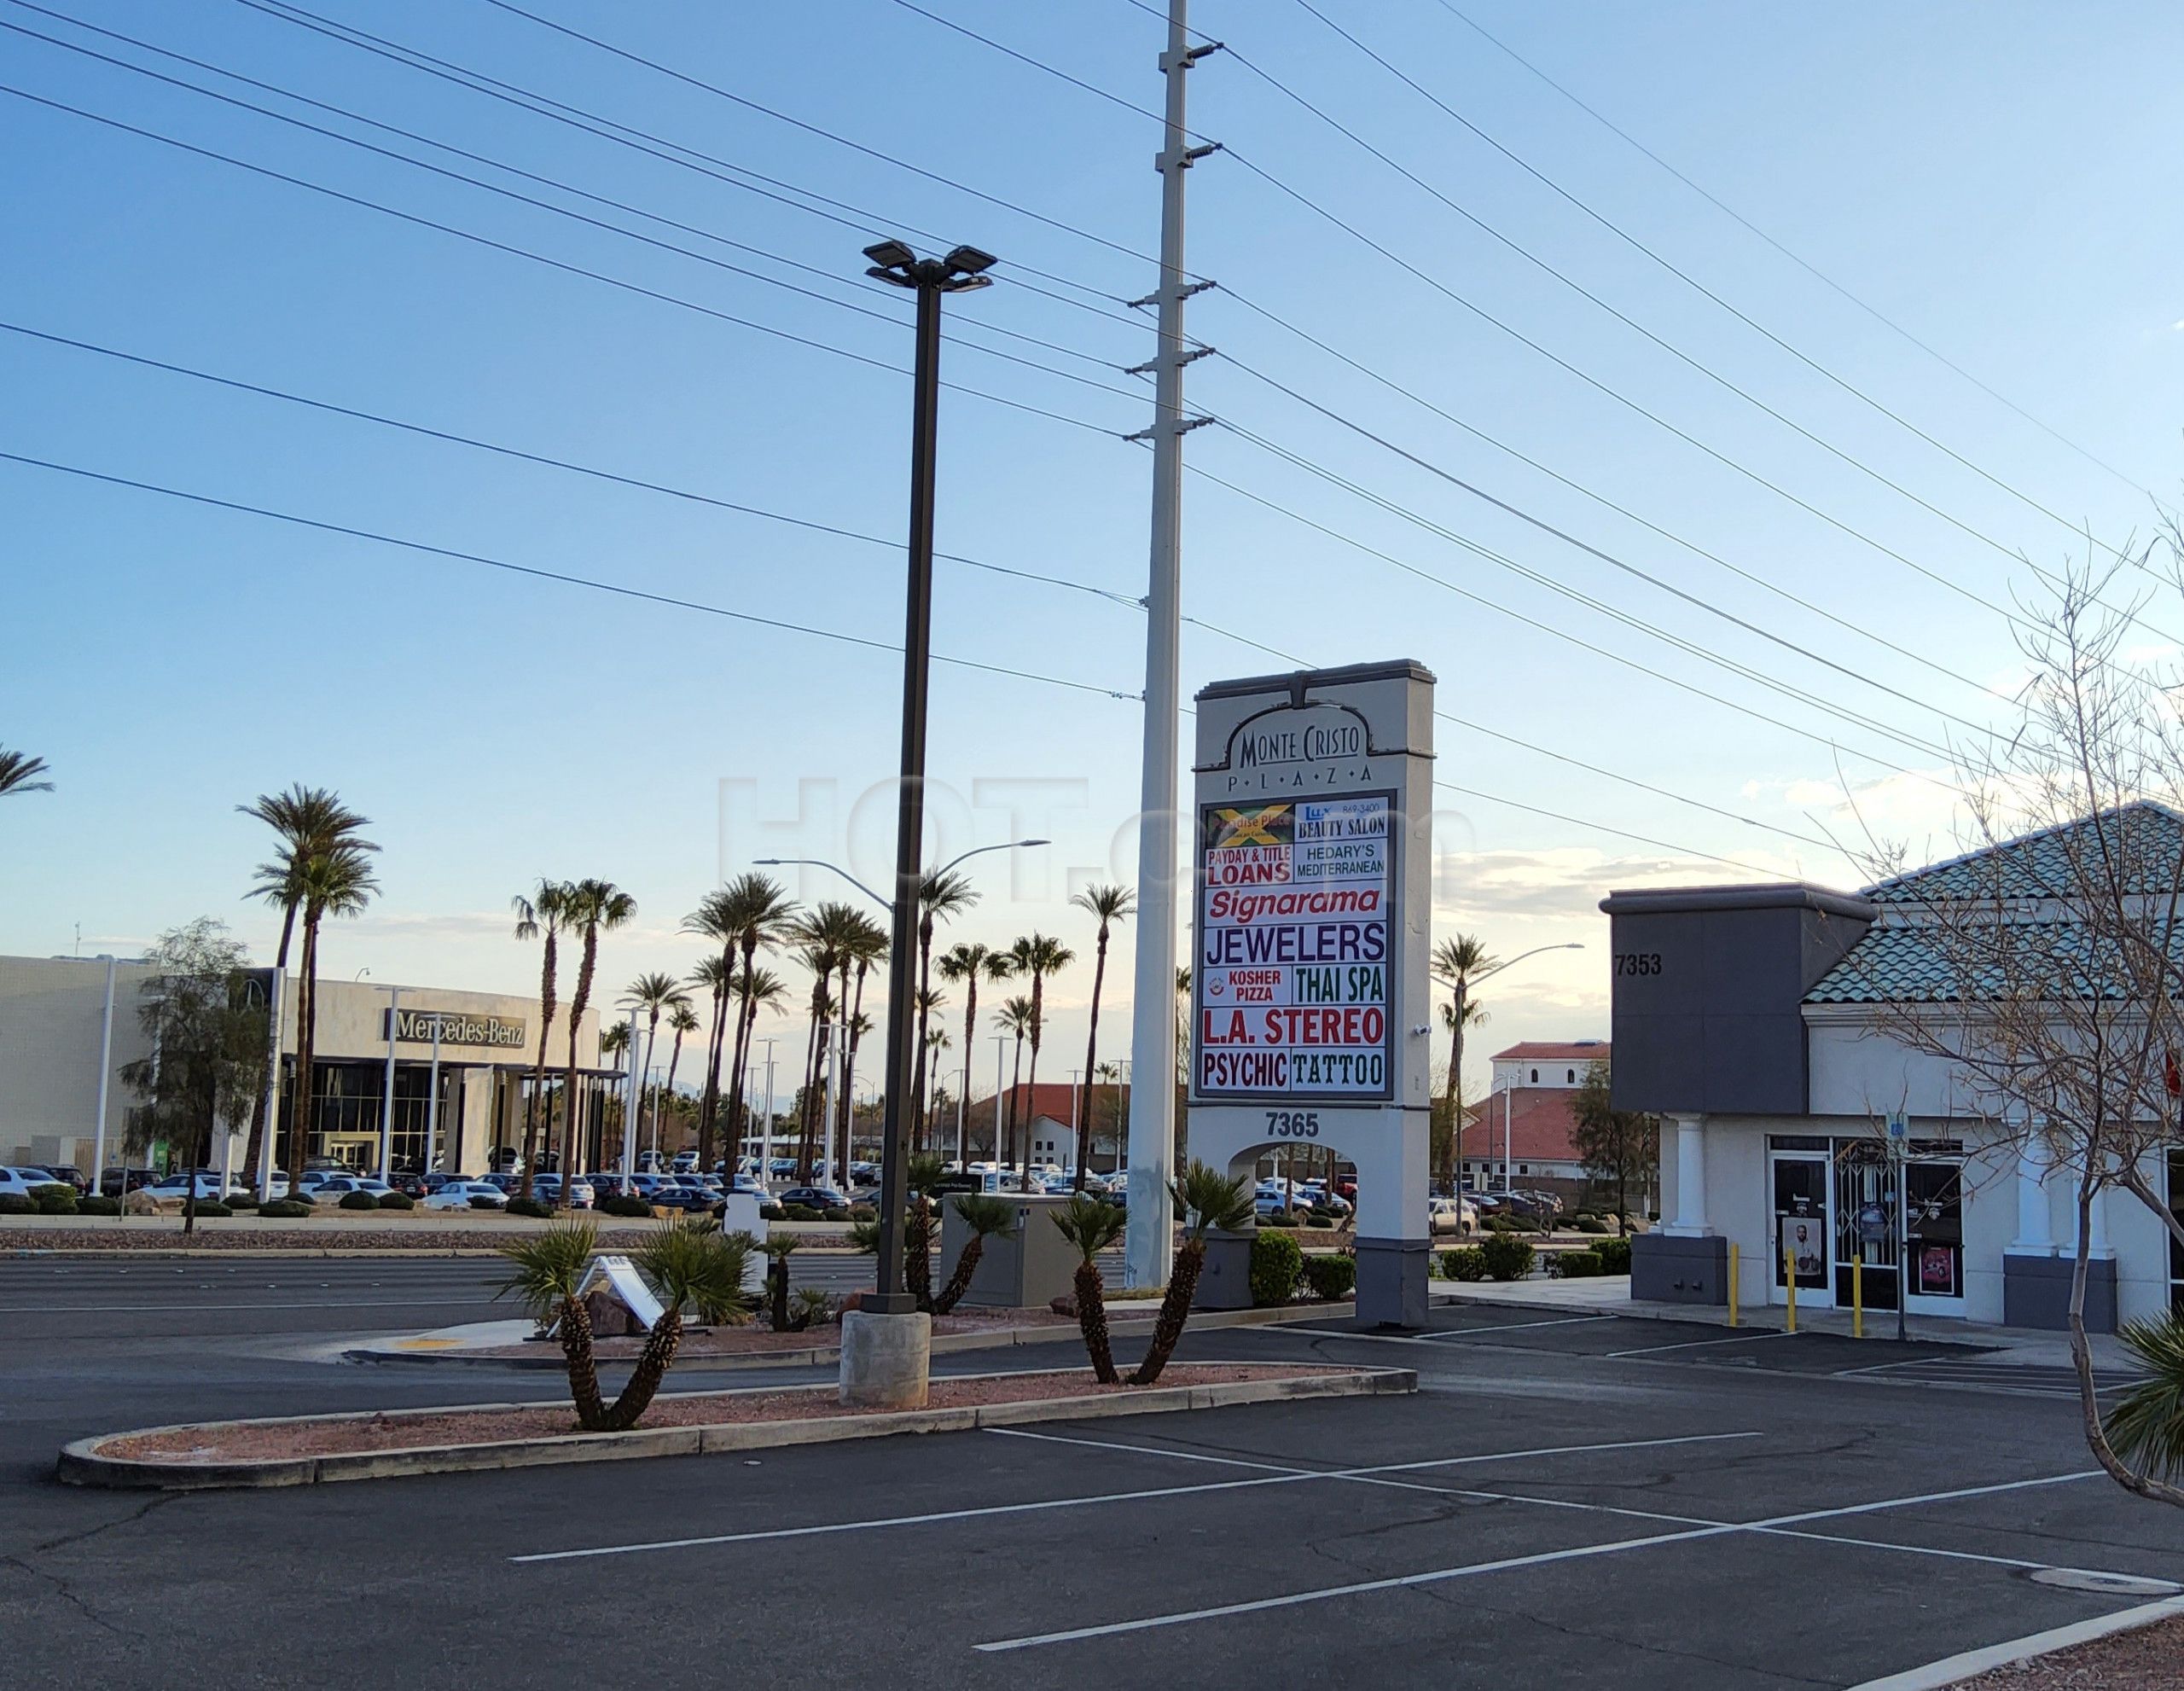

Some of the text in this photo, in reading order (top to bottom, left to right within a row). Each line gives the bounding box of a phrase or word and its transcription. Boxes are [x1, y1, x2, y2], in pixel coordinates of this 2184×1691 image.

[1298, 816, 1385, 839] BEAUTY SALON
[1209, 846, 1291, 864] PAYDAY & TITLE
[1307, 844, 1374, 860] HEDARY'S
[1208, 863, 1291, 886] LOANS
[1298, 861, 1384, 877] MEDITERRANEAN
[1210, 889, 1380, 923] Signarama
[1207, 922, 1385, 965] JEWELERS
[1615, 953, 1662, 976] 7353
[1228, 970, 1281, 986] KOSHER
[1296, 966, 1384, 1002] THAI SPA
[1236, 987, 1273, 1002] PIZZA
[395, 1012, 524, 1045] Mercedes-Benz
[1204, 1008, 1384, 1044] L.A. STEREO
[1204, 1052, 1287, 1087] PSYCHIC
[1292, 1054, 1383, 1085] TATTOO
[1265, 1112, 1319, 1137] 7365
